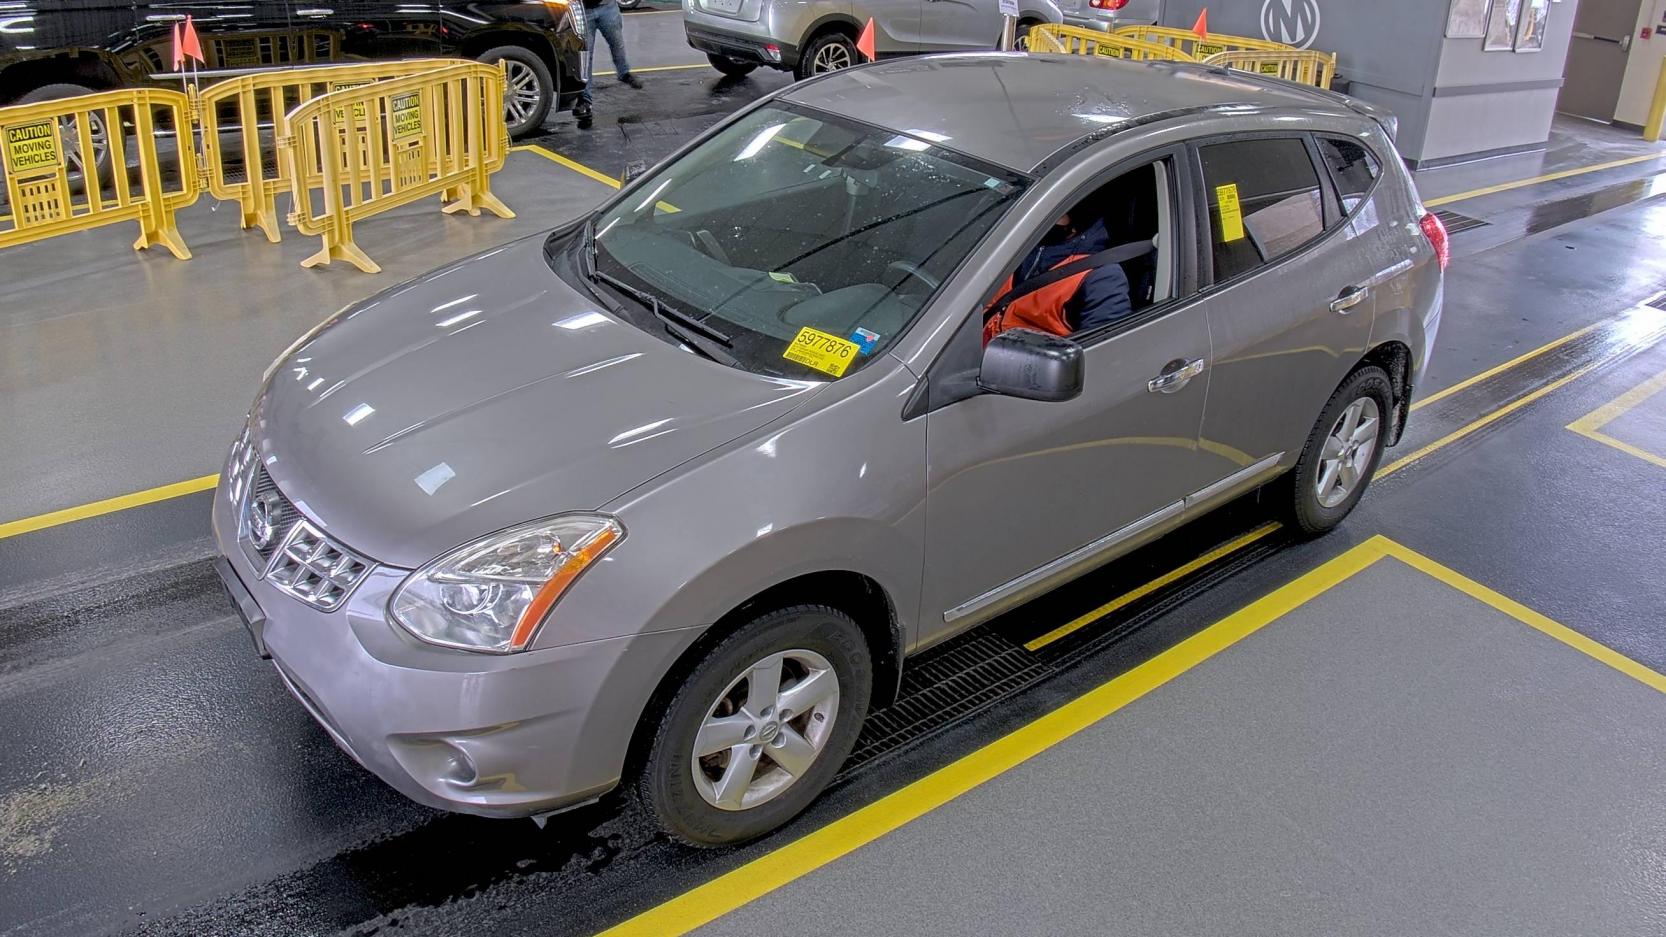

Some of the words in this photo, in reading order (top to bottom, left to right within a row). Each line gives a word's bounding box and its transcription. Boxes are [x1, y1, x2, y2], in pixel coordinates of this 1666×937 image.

[393, 96, 418, 110] CAUTION
[395, 109, 419, 123] MOVING
[10, 124, 51, 141] CAUTION
[394, 120, 421, 134] VEHICLES
[14, 140, 52, 155] MOVING
[13, 151, 56, 166] VEHICLES
[798, 331, 851, 357] 5977876
